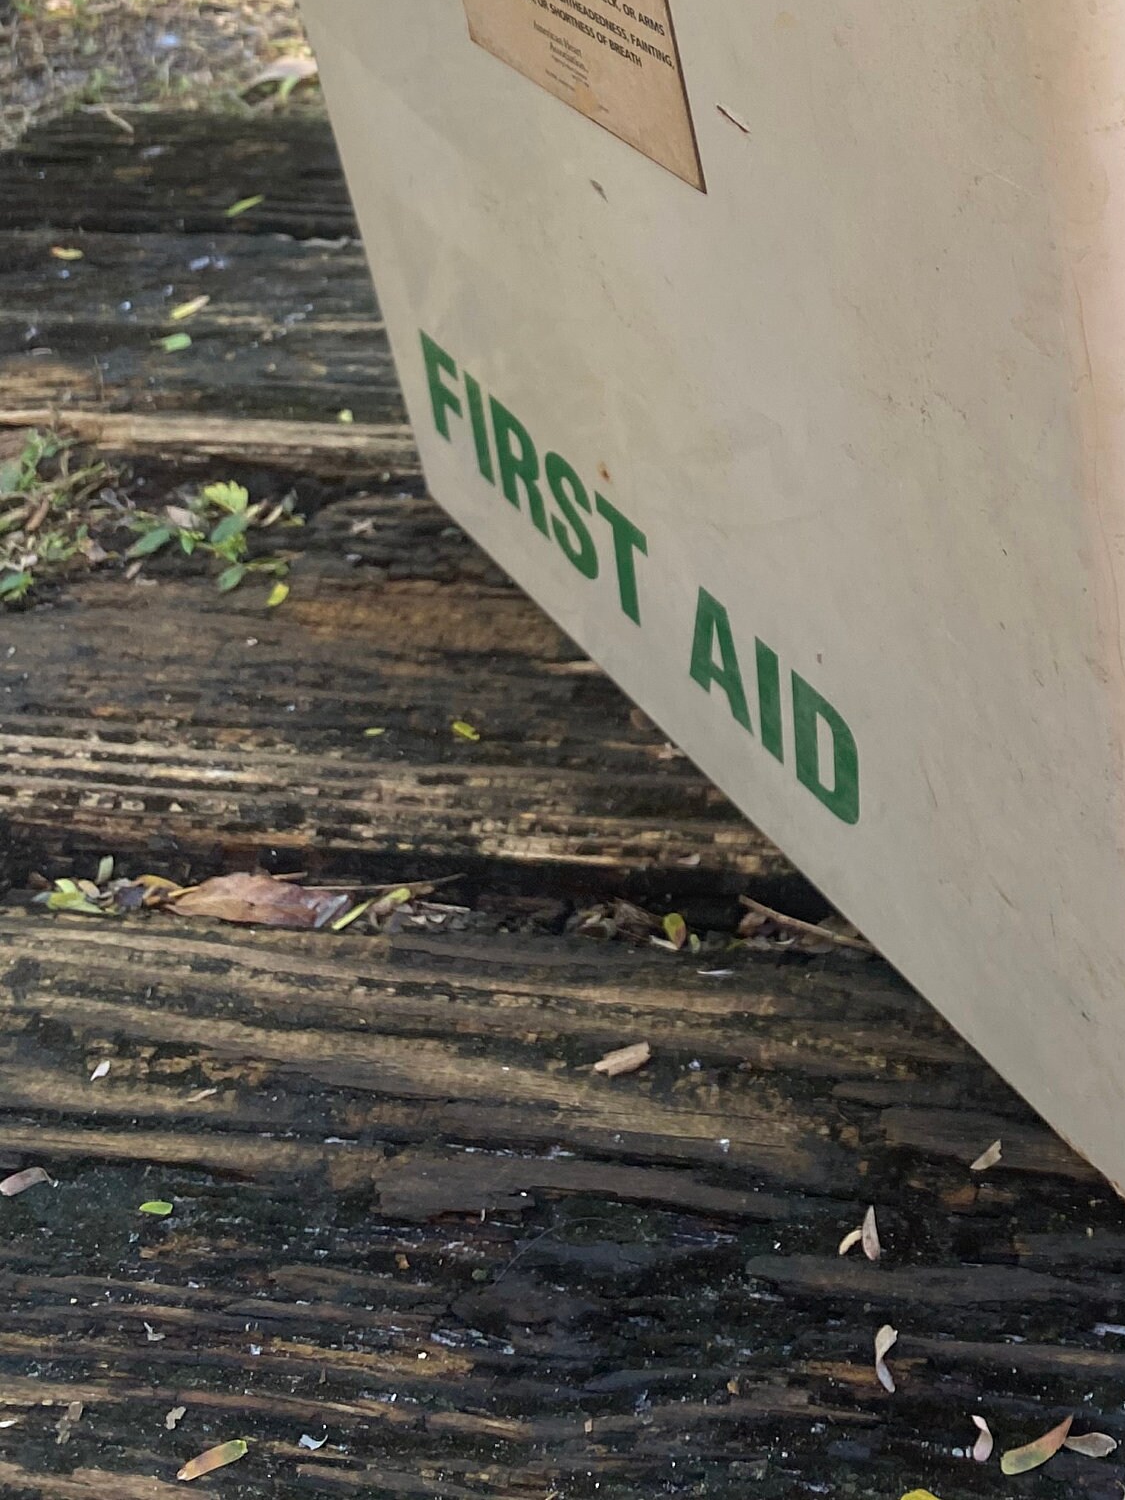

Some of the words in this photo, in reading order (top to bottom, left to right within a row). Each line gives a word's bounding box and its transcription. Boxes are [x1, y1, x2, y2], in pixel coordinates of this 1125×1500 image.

[550, 3, 595, 39] SHORTNESS
[596, 31, 608, 46] OF
[609, 39, 643, 67] BREATH
[622, 3, 636, 19] OR
[637, 11, 665, 36] ARMS
[630, 33, 675, 70] FAINTING,
[419, 328, 649, 629] FIRST
[690, 585, 860, 826] AID
